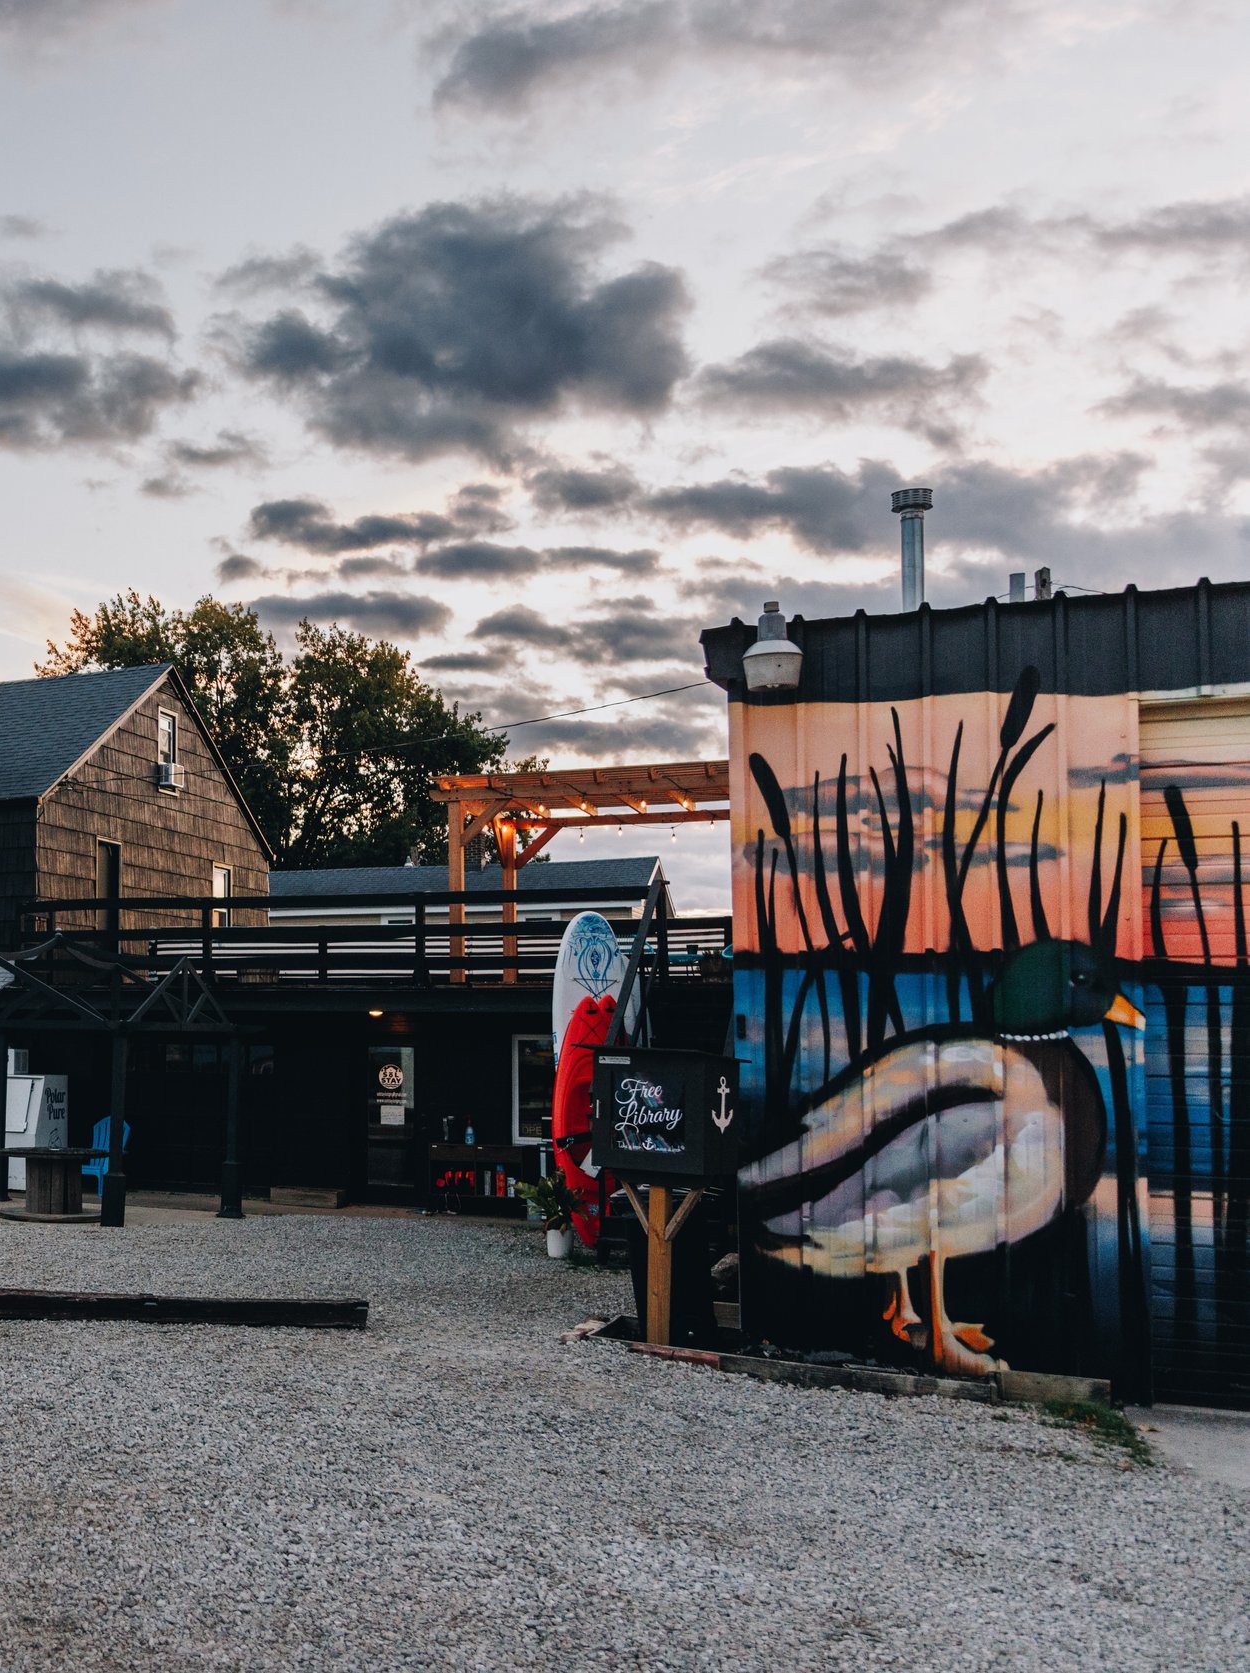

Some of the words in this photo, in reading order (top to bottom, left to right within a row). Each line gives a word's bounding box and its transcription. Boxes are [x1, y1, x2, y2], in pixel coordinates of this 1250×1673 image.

[44, 1087, 66, 1104] Polar
[615, 1078, 662, 1105] Free
[47, 1103, 66, 1120] Pure
[614, 1100, 683, 1132] Library
[521, 1126, 543, 1136] OPE
